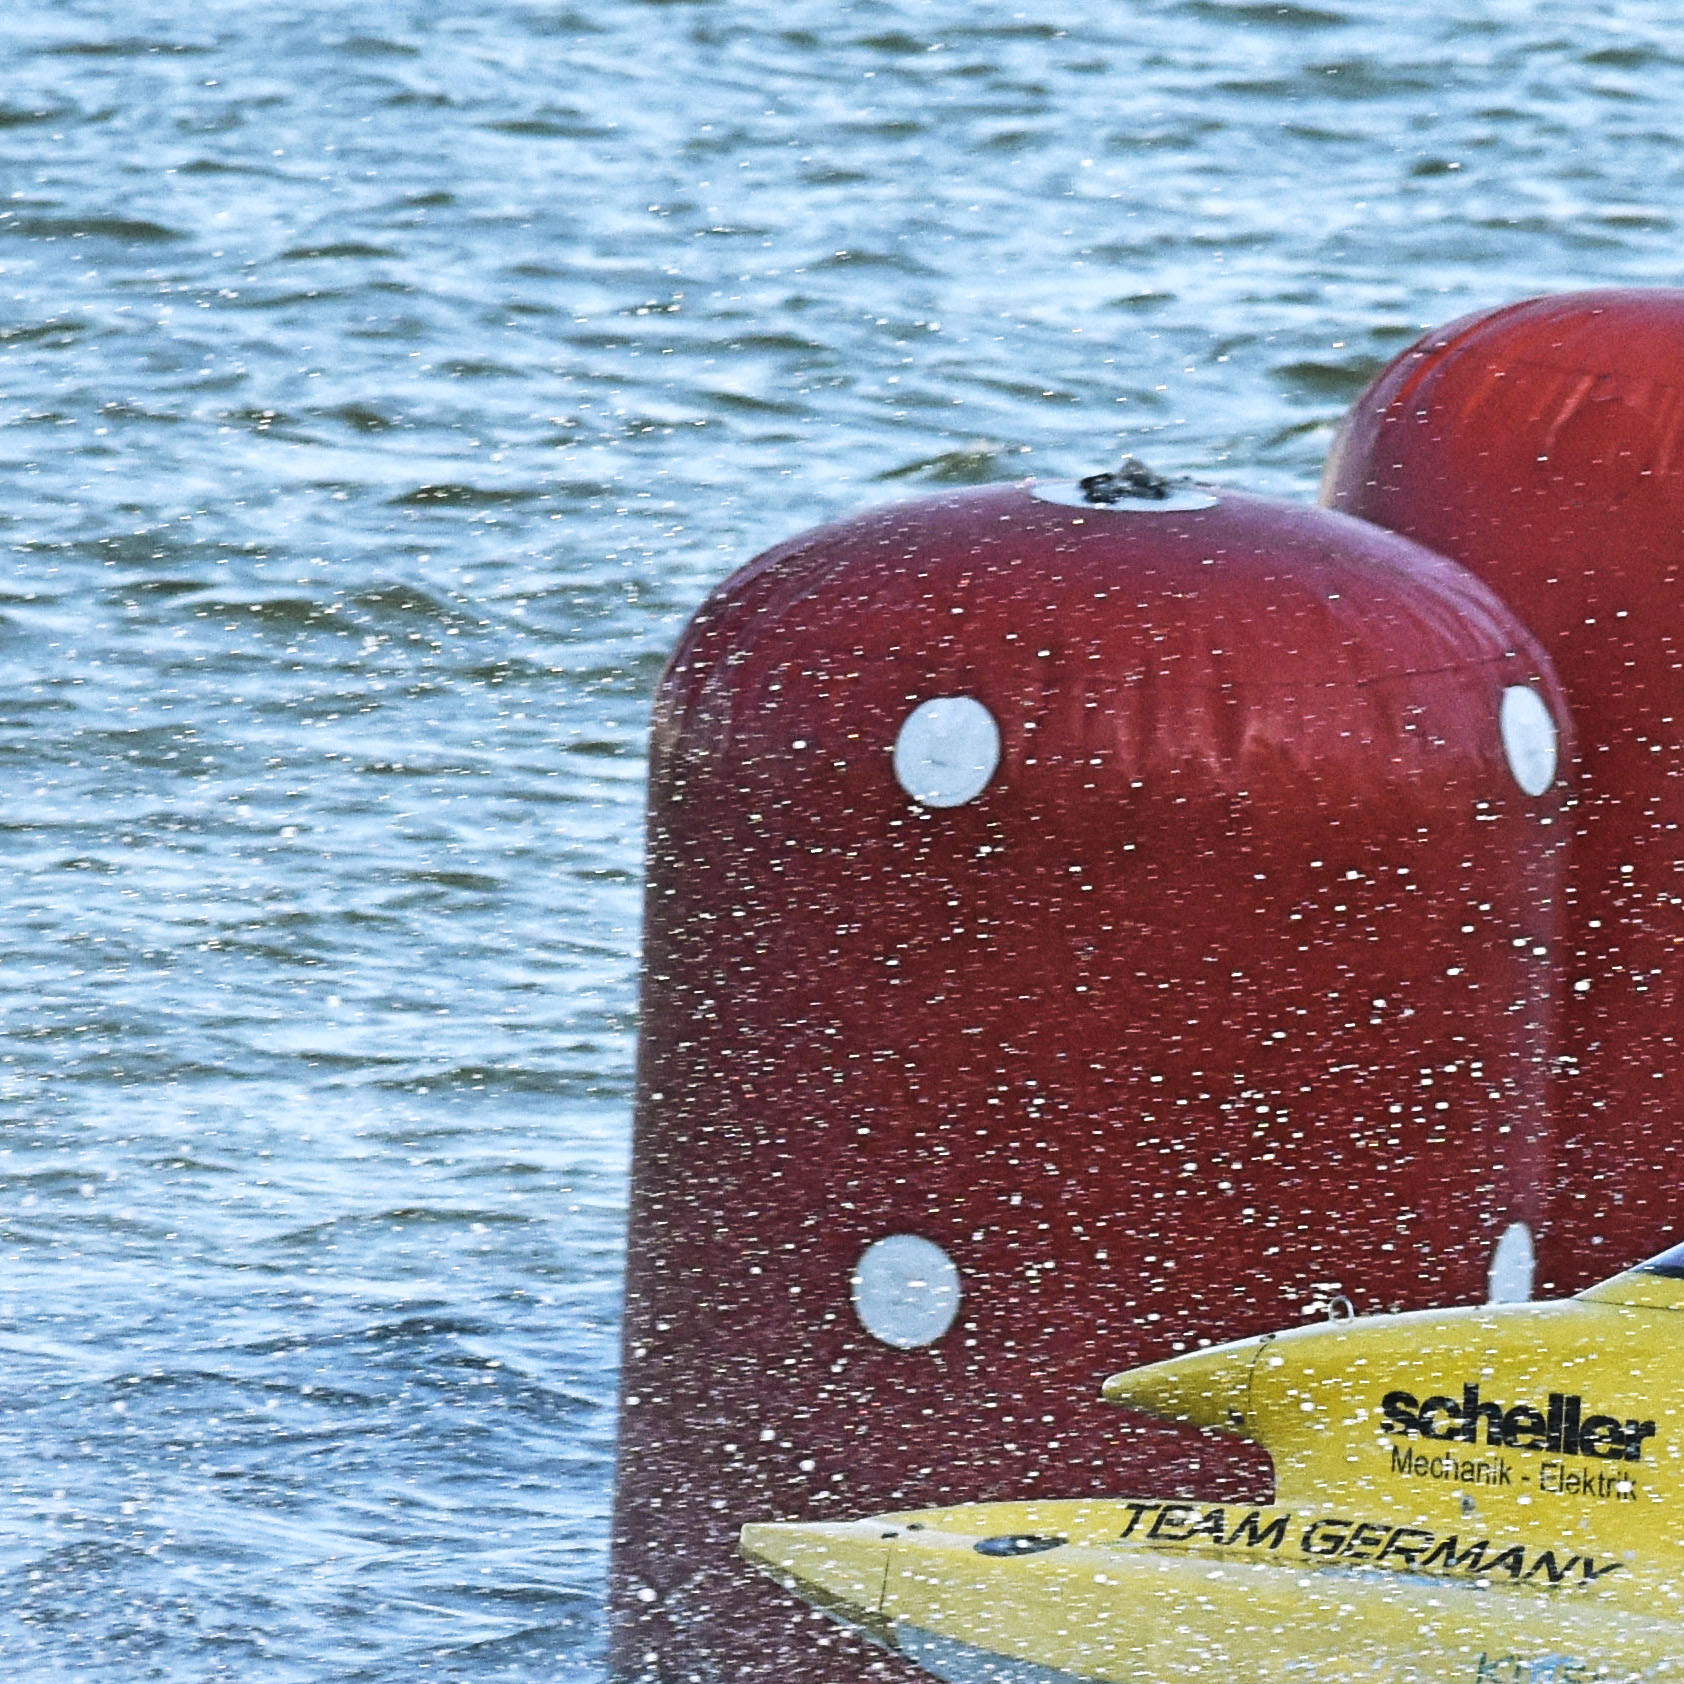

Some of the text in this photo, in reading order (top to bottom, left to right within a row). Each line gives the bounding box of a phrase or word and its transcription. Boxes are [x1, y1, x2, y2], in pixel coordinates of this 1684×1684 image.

[1380, 1381, 1656, 1462] scheller
[1391, 1445, 1512, 1486] Mechanik
[1540, 1459, 1638, 1500] Elektrik
[1119, 1501, 1626, 1588] TEAM GERMANY
